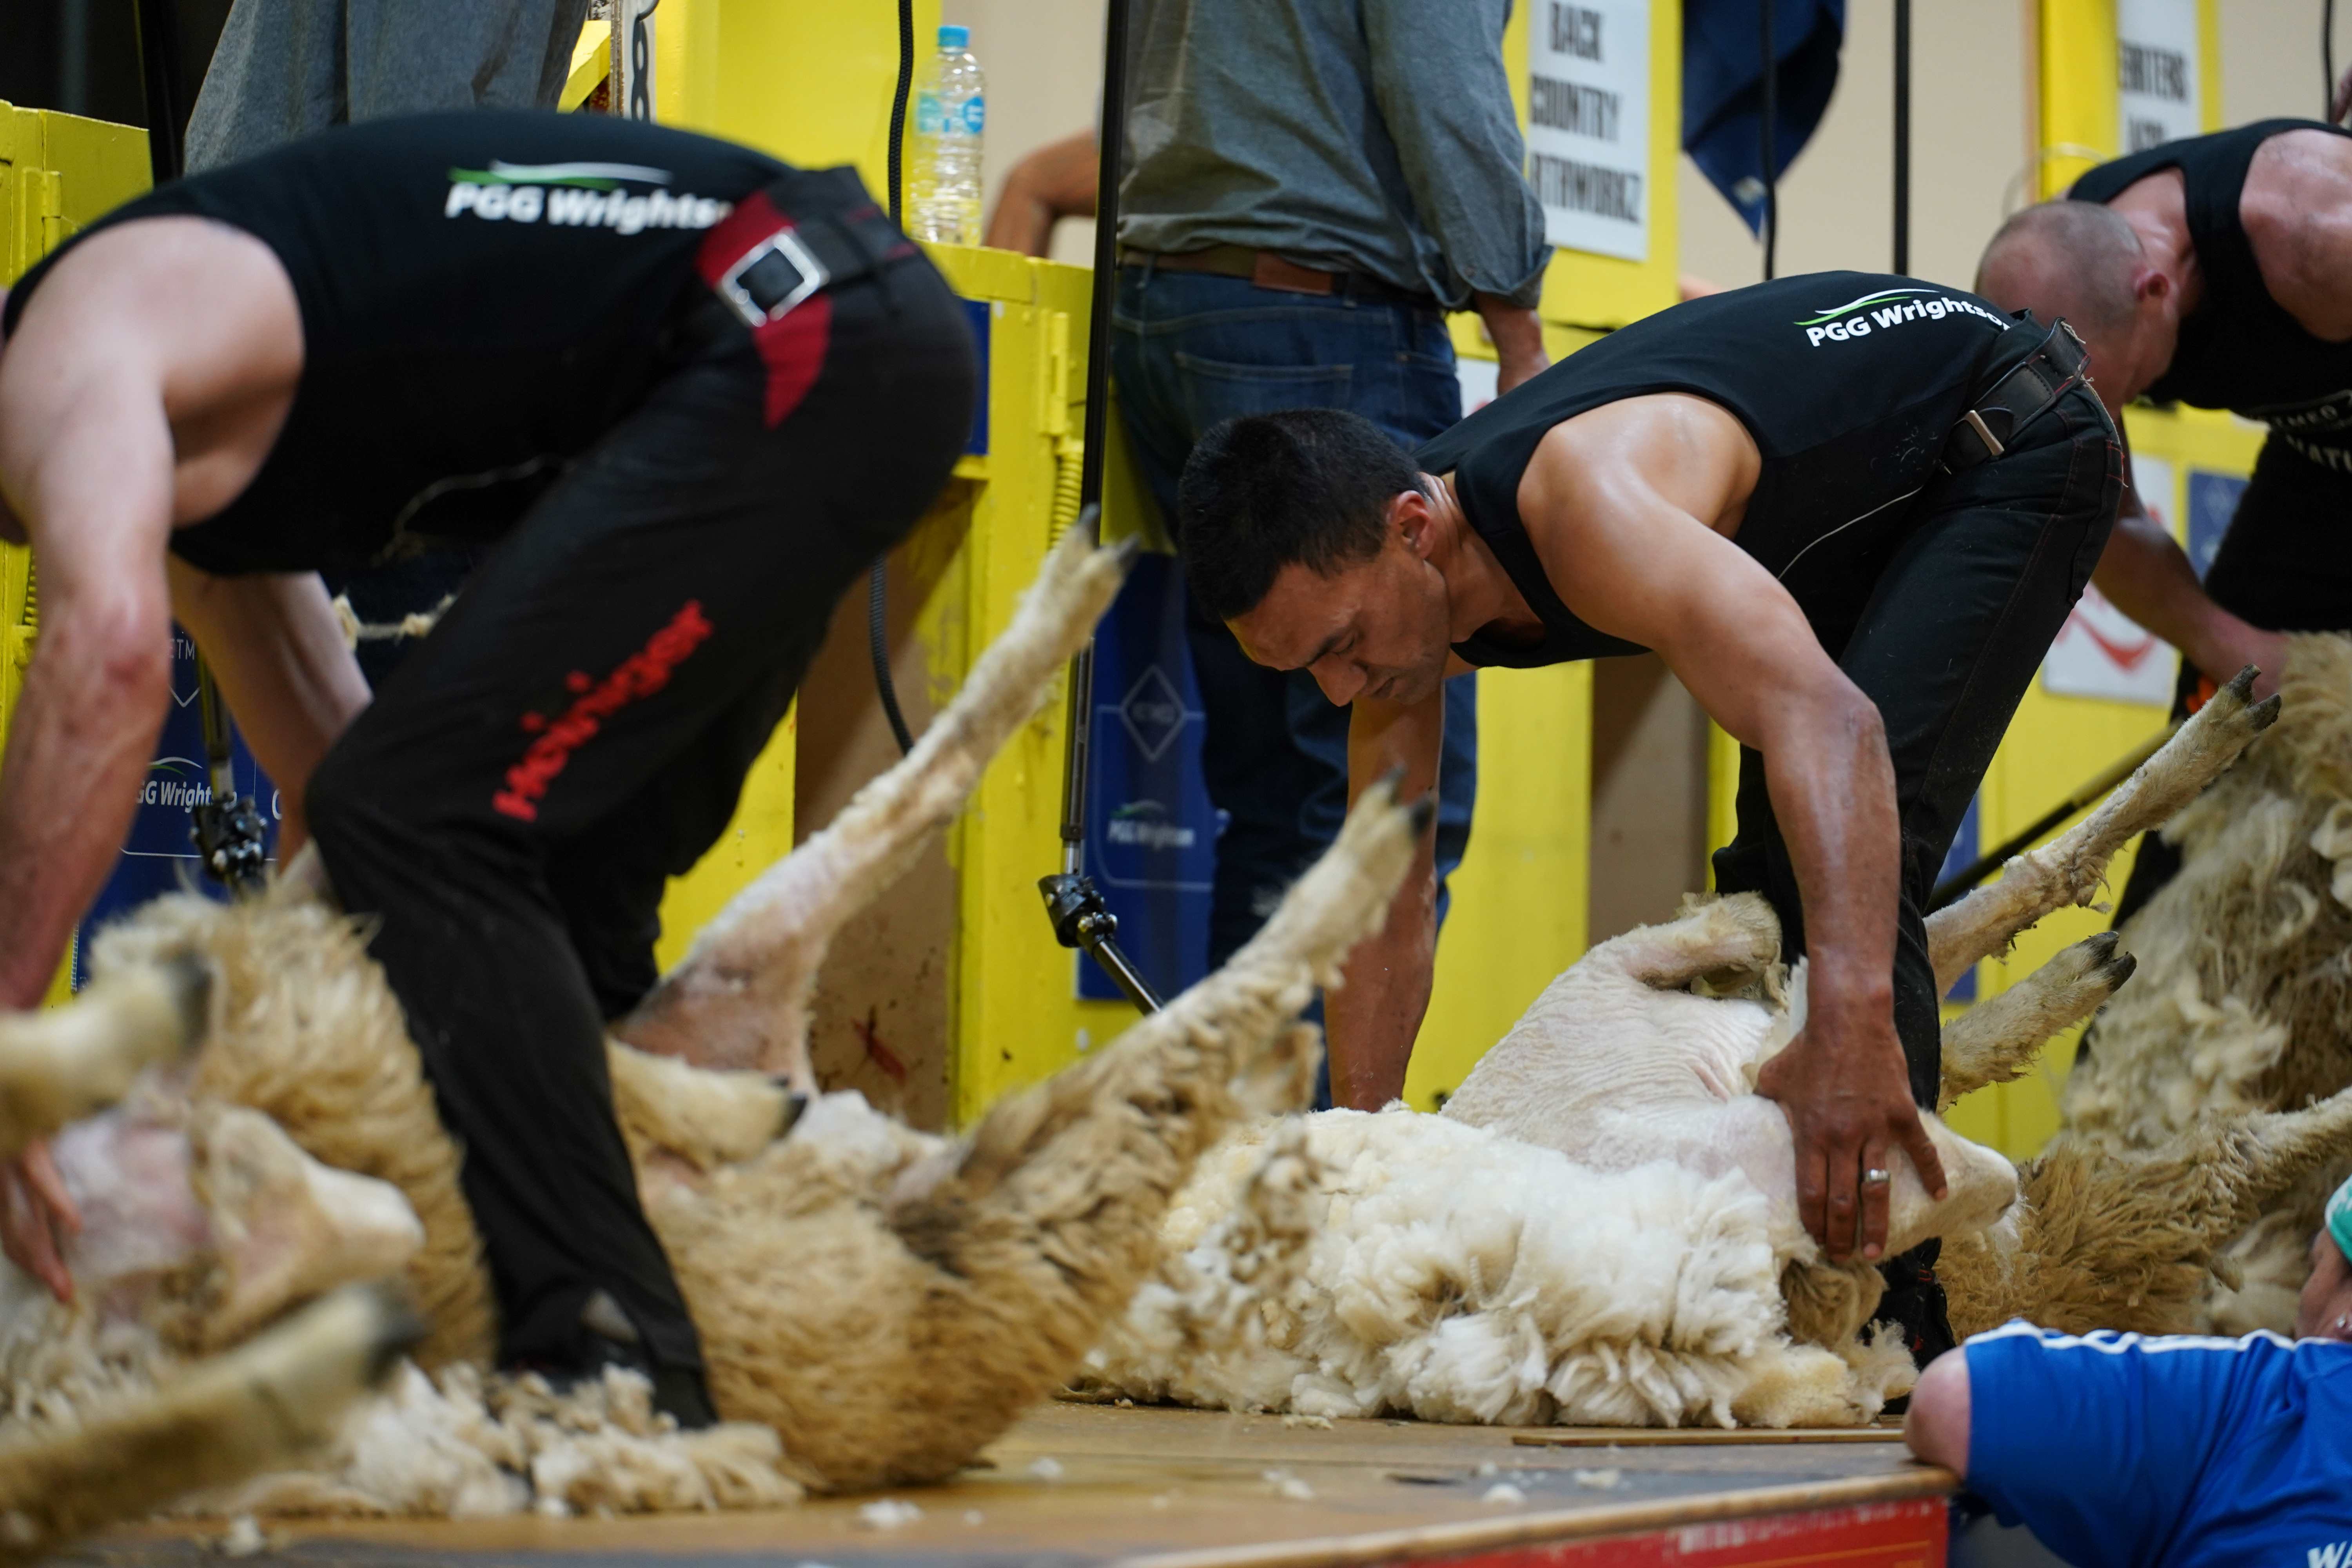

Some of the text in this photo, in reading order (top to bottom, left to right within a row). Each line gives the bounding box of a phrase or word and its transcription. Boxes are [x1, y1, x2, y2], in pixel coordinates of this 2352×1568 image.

[1550, 1, 1602, 63] BACK
[1530, 73, 1622, 143] COUNTRY
[444, 181, 545, 223] PGG
[1805, 316, 1872, 347] PGG
[160, 781, 215, 814] Wright
